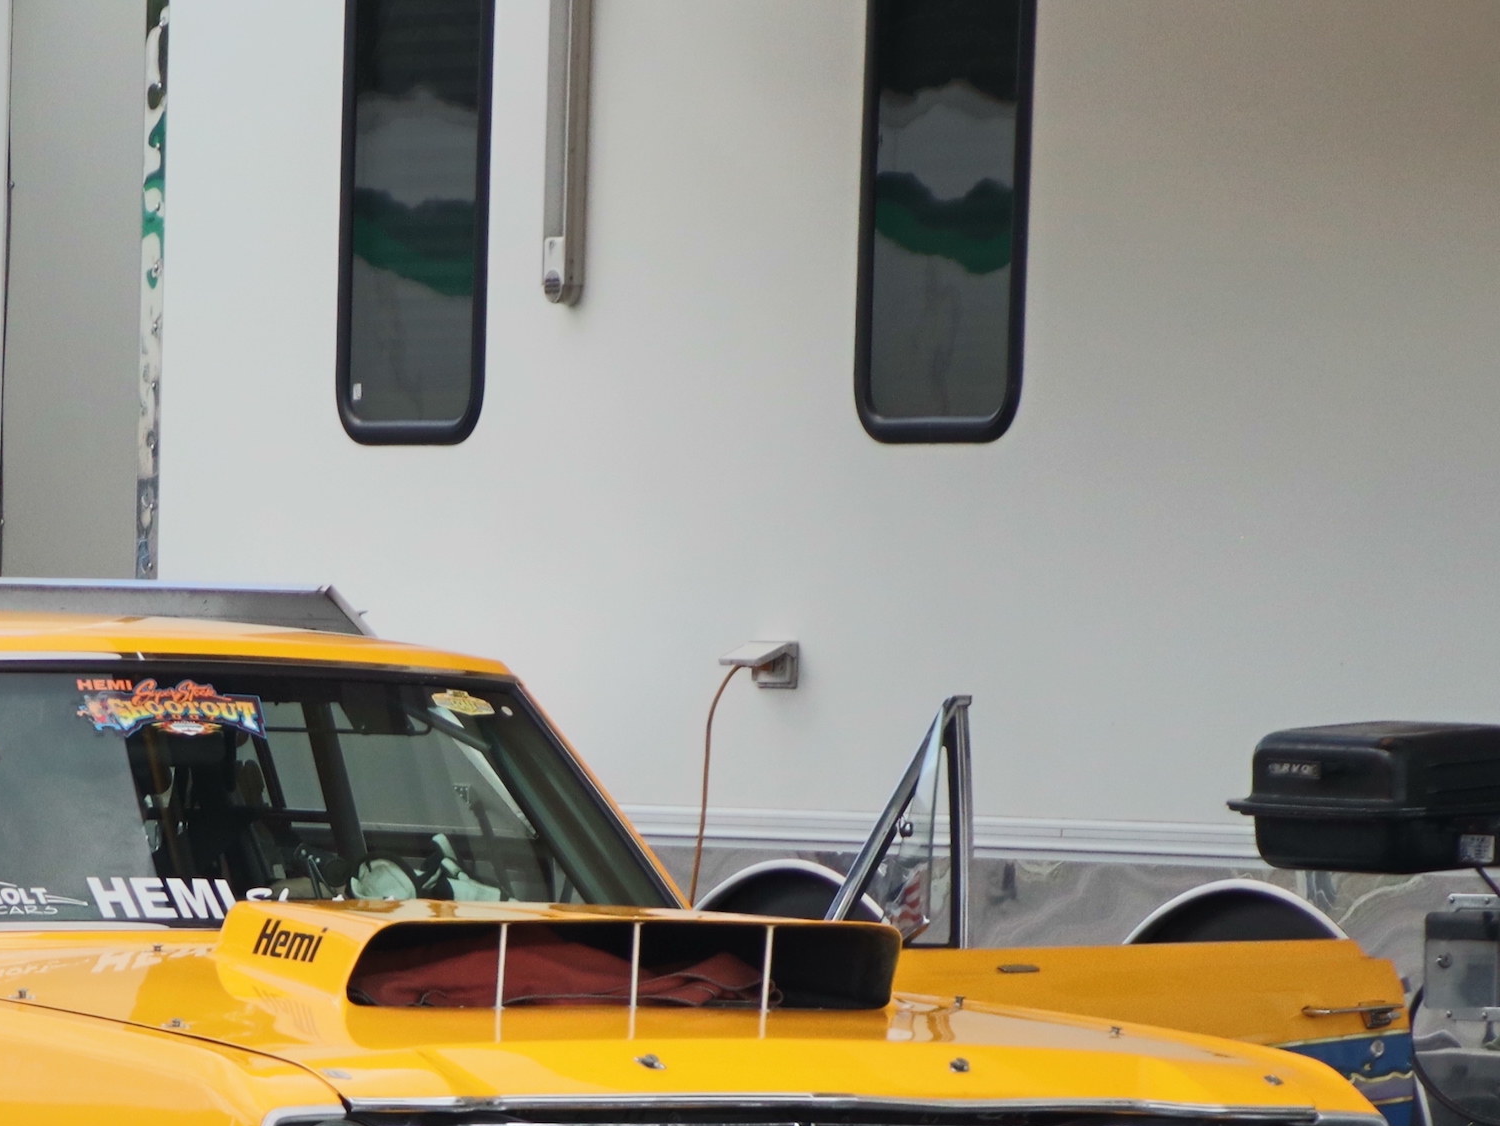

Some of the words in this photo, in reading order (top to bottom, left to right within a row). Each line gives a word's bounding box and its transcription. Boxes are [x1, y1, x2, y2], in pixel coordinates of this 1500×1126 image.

[77, 679, 132, 691] HEMI
[108, 700, 260, 731] SHOOTOUT
[86, 877, 236, 920] HEMI
[252, 918, 329, 964] Hemi
